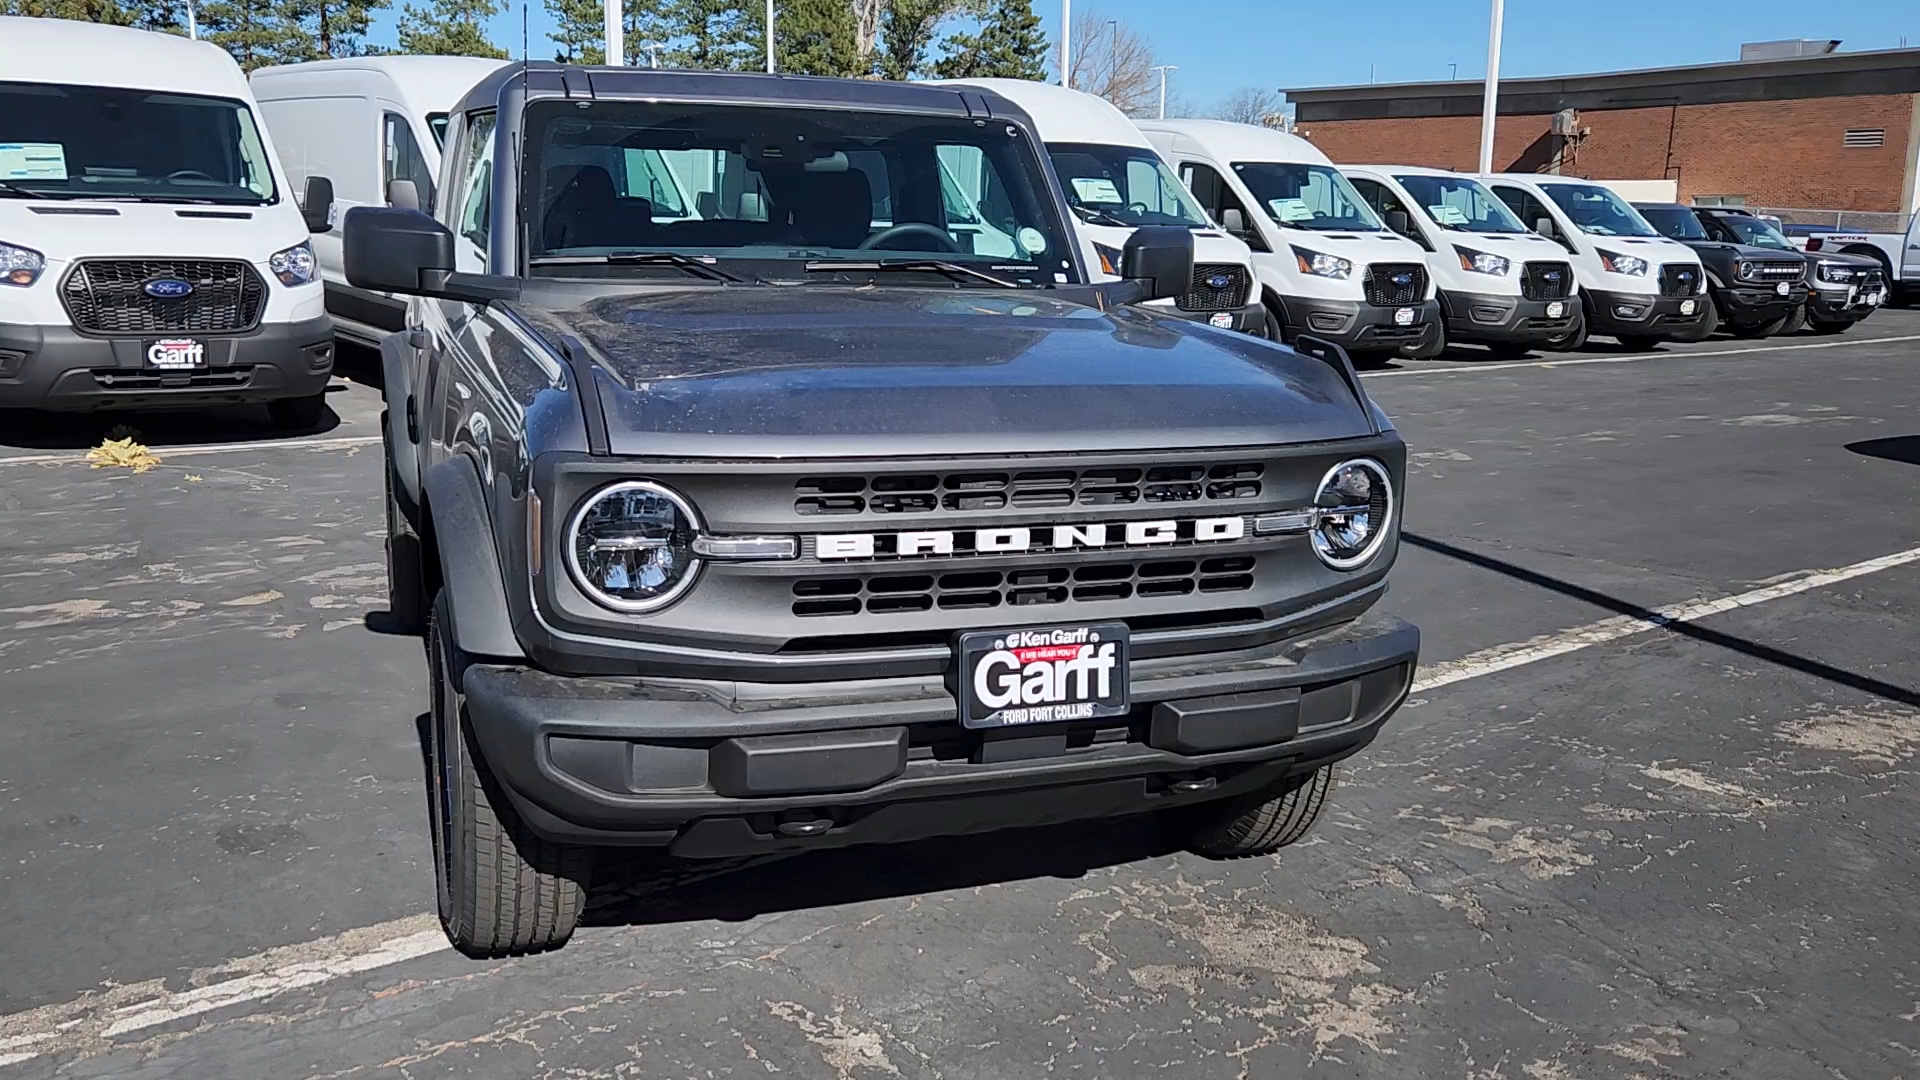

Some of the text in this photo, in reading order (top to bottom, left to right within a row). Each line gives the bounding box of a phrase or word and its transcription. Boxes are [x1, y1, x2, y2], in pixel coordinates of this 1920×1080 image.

[148, 344, 204, 365] Garff
[816, 516, 1245, 559] BRONCO
[1020, 631, 1050, 647] Ken
[1051, 628, 1089, 645] Garff
[1025, 648, 1071, 659] WE HEAR YOU
[974, 643, 1115, 708] Garff
[1003, 703, 1094, 724] FORD FORT COLLINS
